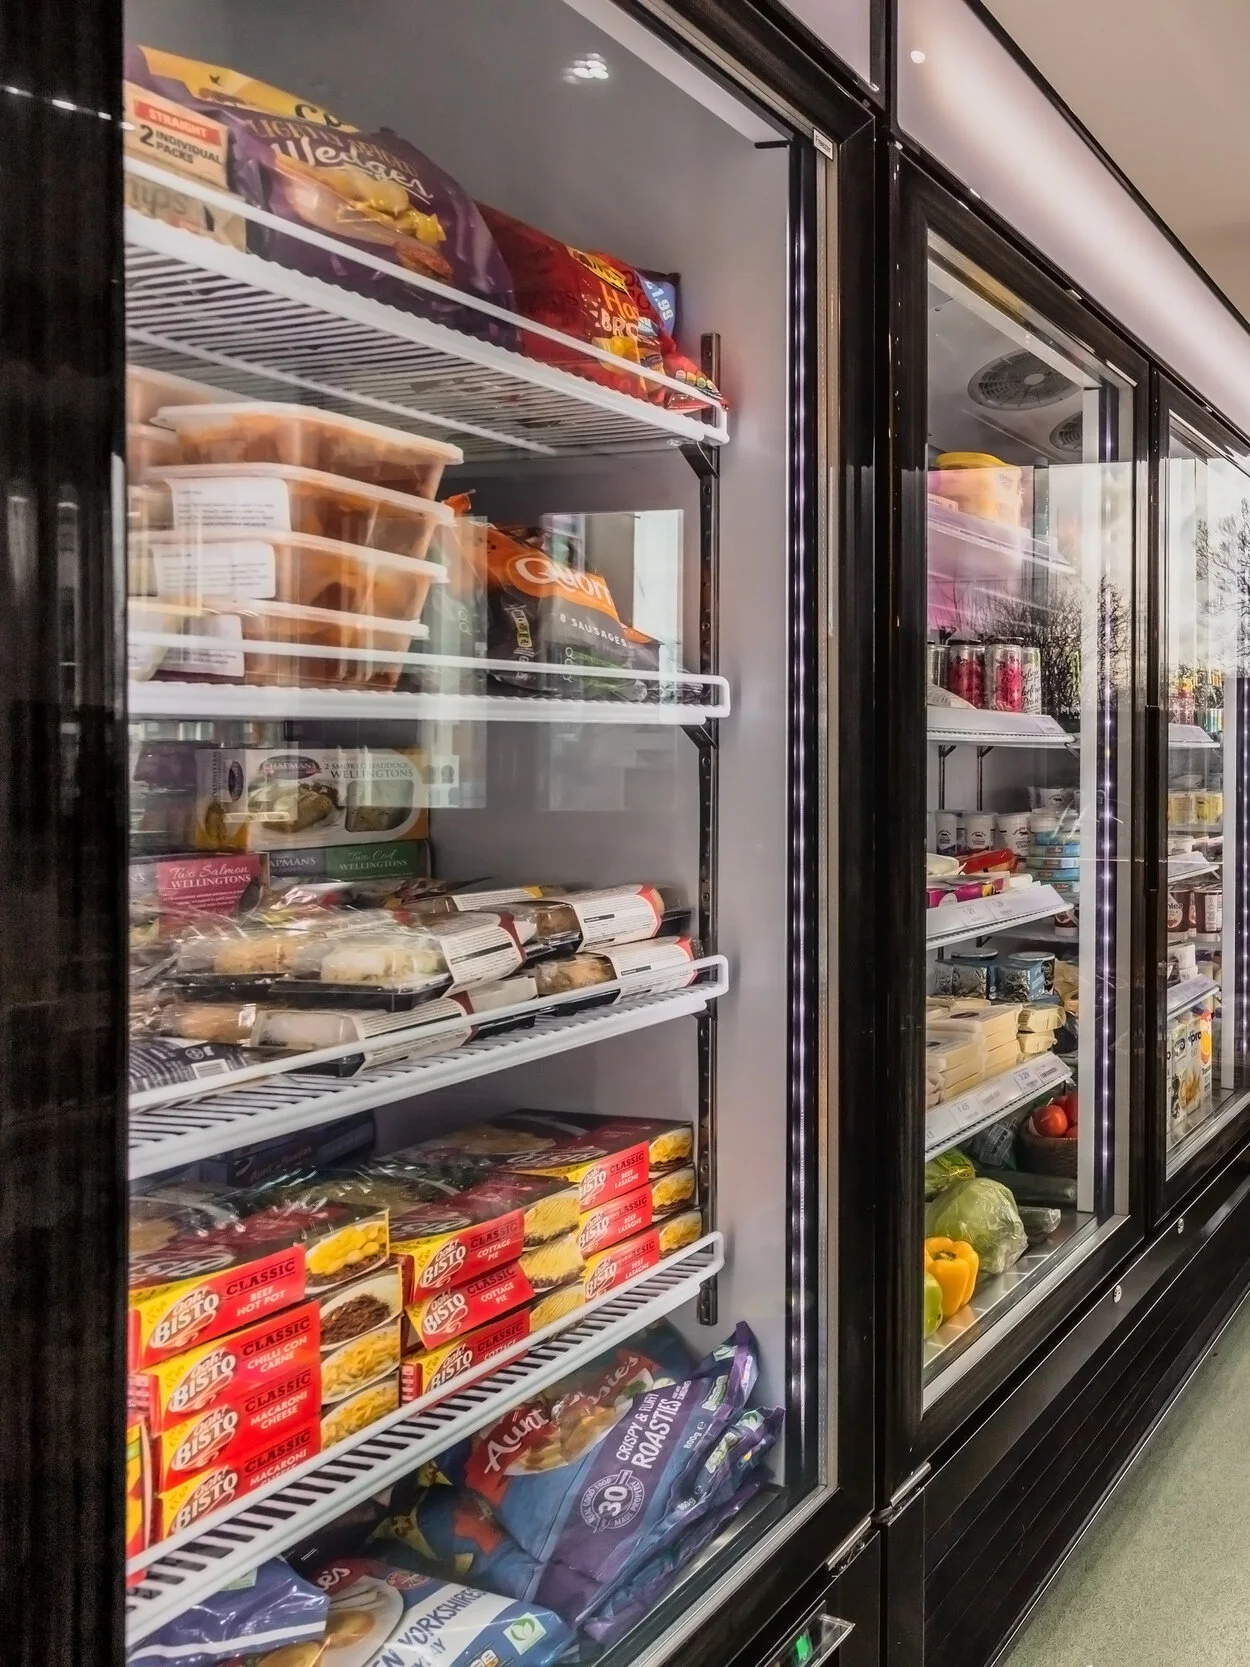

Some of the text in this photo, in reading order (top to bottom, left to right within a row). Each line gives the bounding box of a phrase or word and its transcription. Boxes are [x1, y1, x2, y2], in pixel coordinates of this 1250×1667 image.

[148, 105, 209, 139] STRAIGHT
[139, 124, 224, 166] 2 INDIVIDUAL
[155, 142, 196, 165] PACKS
[599, 281, 640, 321] Has
[514, 556, 615, 608] Quorn
[559, 613, 628, 648] 8 SAUSAGES
[330, 768, 414, 780] WELLINGTONS
[169, 864, 250, 881] Two Salmon
[268, 856, 316, 868] APMAN'S
[338, 858, 408, 870] WELLINGTONS
[170, 874, 252, 890] WELLINGTONS
[610, 1152, 645, 1174] CLASSIC
[620, 1168, 634, 1180] BEEF
[579, 1170, 606, 1198] ISTO
[614, 1173, 639, 1189] LASAGNE
[578, 1216, 610, 1250] BISTO
[618, 1218, 642, 1234] LASAGNE
[624, 1214, 637, 1224] BEEF
[470, 1222, 518, 1249] CLASSIC
[476, 1238, 511, 1259] COTTAGE
[422, 1246, 467, 1287] BISTO
[488, 1251, 499, 1261] PIE
[624, 1262, 650, 1280] LASAGNE
[631, 1258, 644, 1269] BEEF
[226, 1260, 297, 1296] CLASSIC
[250, 1285, 274, 1302] BEEF
[466, 1268, 516, 1294] CLASSIC
[480, 1282, 516, 1302] COTTAGE
[585, 1261, 618, 1299] BISTO
[236, 1290, 287, 1318] HOT POT
[424, 1293, 466, 1333] BISTO
[496, 1294, 509, 1305] PIE
[151, 1292, 220, 1347] BISTO
[242, 1316, 311, 1357] CLASSIC
[478, 1320, 524, 1352] CLASSIC
[246, 1336, 308, 1370] CHILLI CON
[260, 1350, 296, 1374] CARNE
[170, 1354, 237, 1409] BISTO
[430, 1350, 474, 1392] BISTO
[244, 1372, 312, 1412] CLASSIC
[250, 1391, 308, 1426] MACARONI
[260, 1406, 299, 1430] CHEESE
[171, 1411, 238, 1469] BISTO
[483, 1407, 550, 1474] Aunt
[616, 1421, 644, 1462] CRISPY
[634, 1413, 648, 1422] &
[630, 1398, 682, 1470] ROASTIES
[244, 1430, 312, 1473] CLASSIC
[250, 1449, 308, 1487] MACARONI
[171, 1469, 238, 1532] BISTO
[598, 1486, 628, 1517] 30
[400, 1586, 488, 1648] YORKSHIRES
